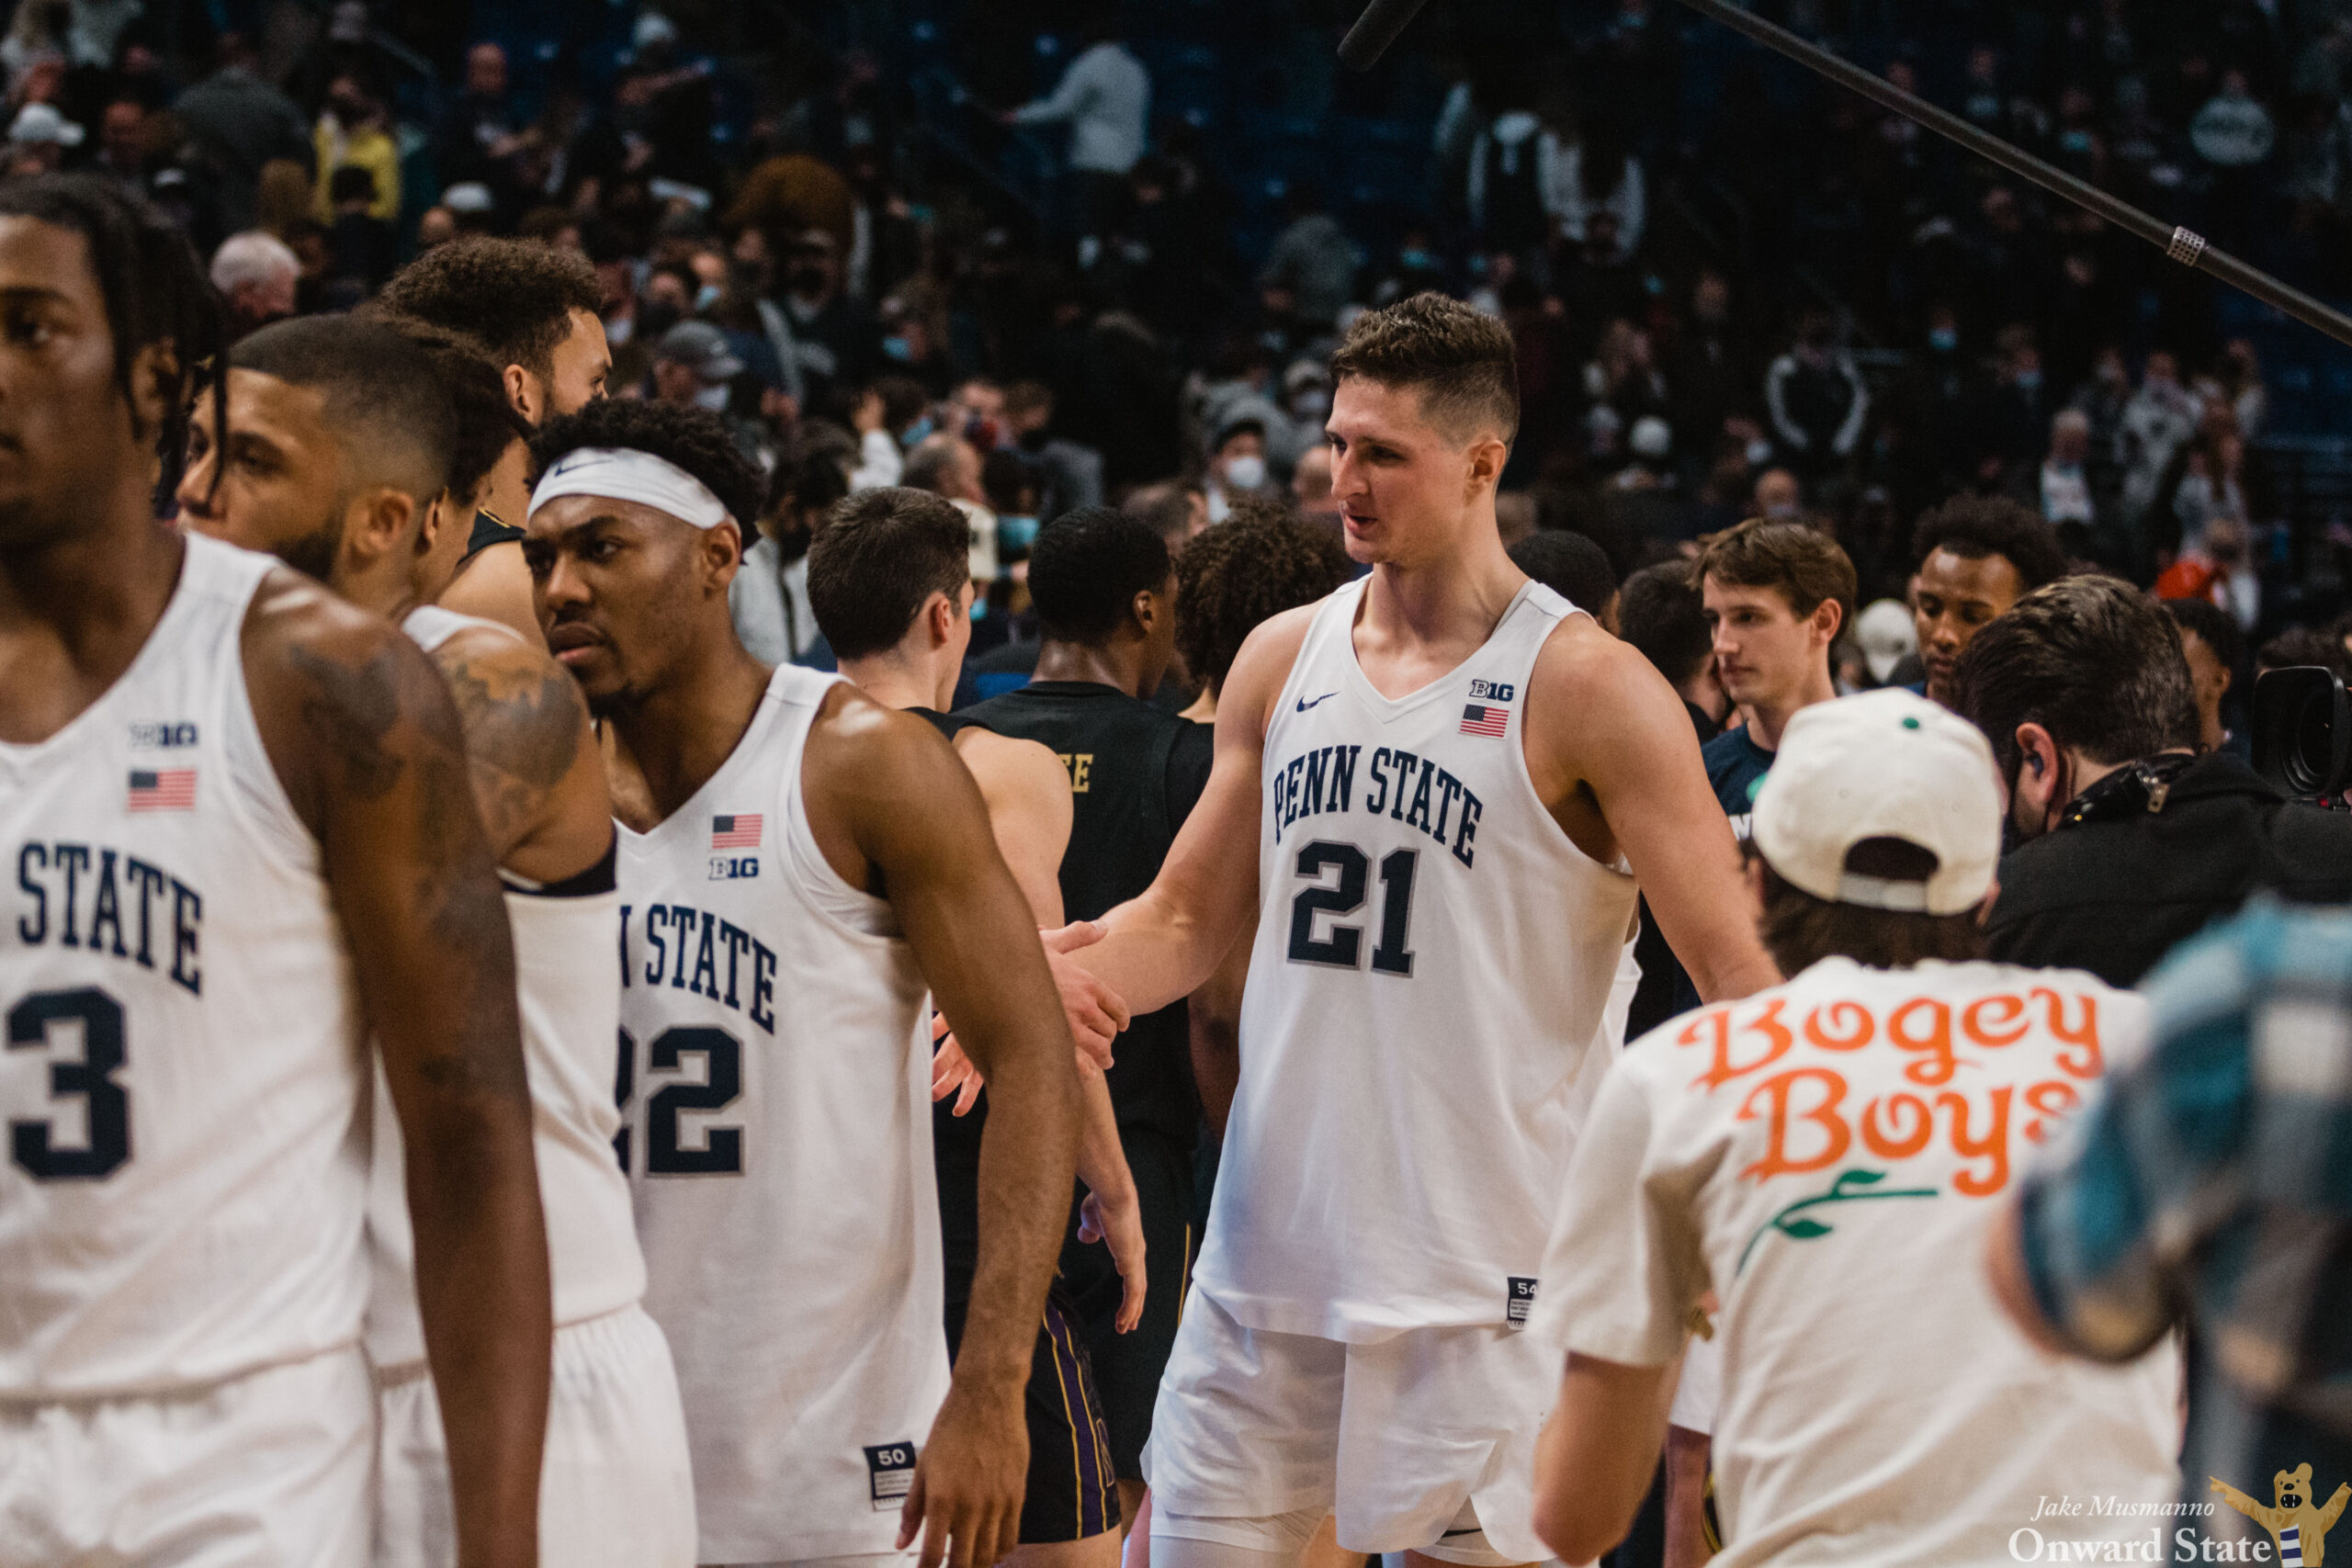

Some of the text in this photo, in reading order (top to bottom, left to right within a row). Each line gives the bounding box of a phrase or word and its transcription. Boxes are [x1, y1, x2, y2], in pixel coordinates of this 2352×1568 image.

[1273, 745, 1484, 870] PENN STATE
[17, 841, 204, 998] STATE
[646, 903, 777, 1036] STATE
[1286, 838, 1421, 979] 21
[6, 985, 134, 1185] 3
[1677, 987, 2104, 1093] Bogey
[877, 1448, 907, 1466] 50
